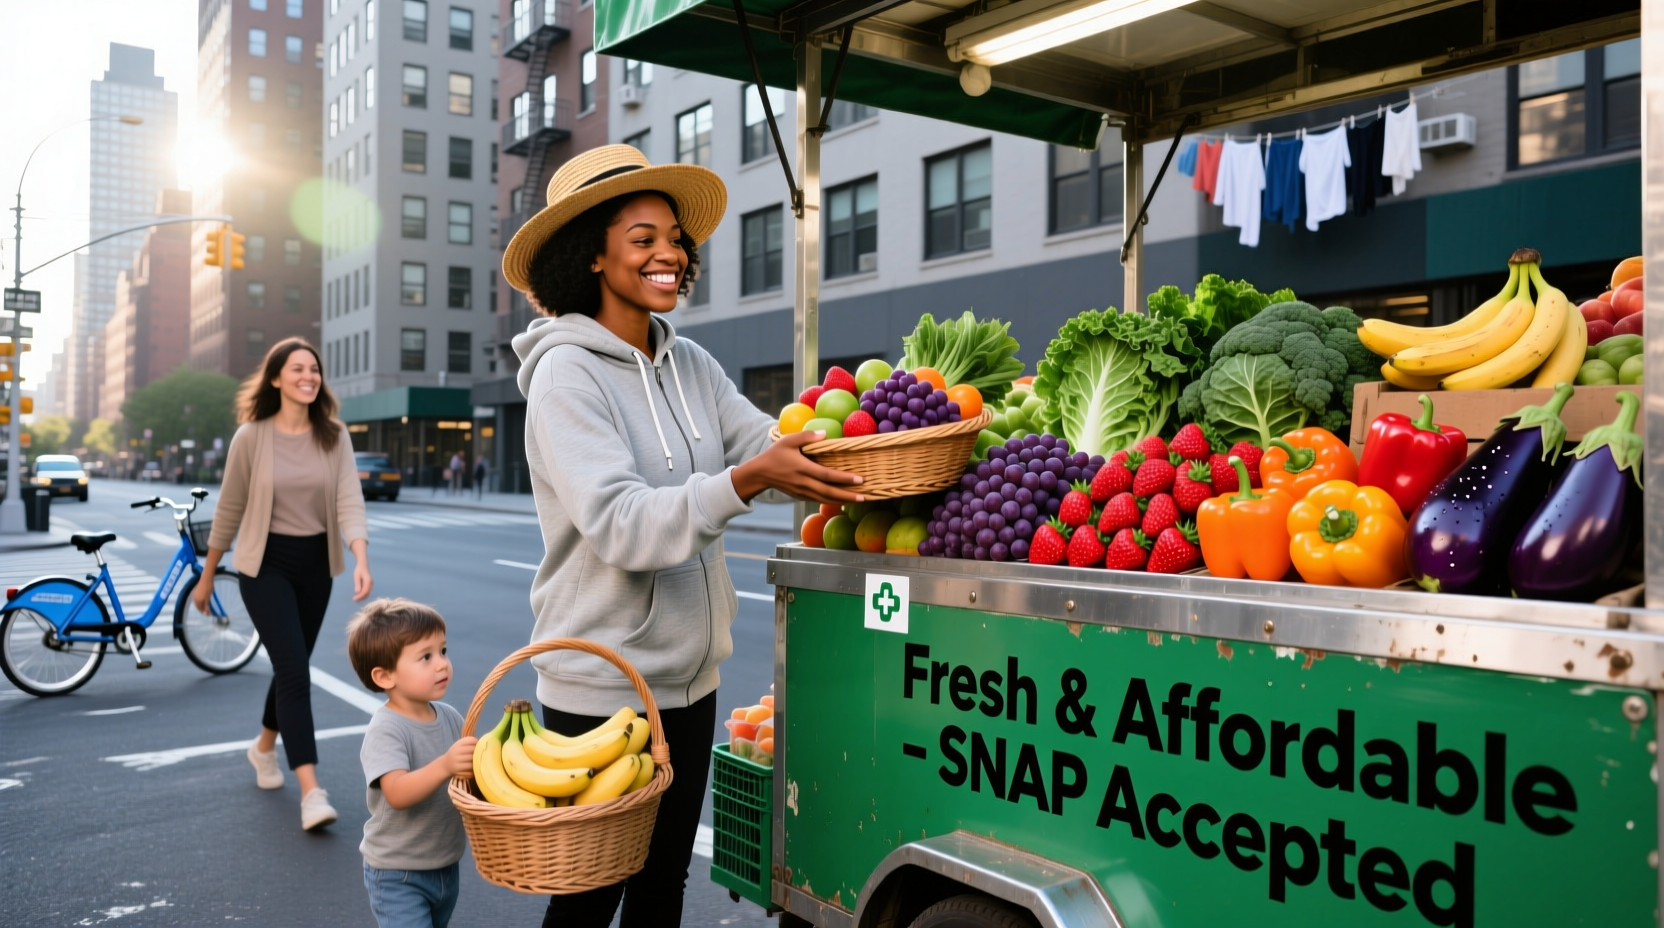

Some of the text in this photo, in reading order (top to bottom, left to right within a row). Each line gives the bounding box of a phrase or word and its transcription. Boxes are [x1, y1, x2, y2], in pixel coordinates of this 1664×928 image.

[903, 642, 1579, 837] Fresh & Affordable
[938, 724, 1088, 816] SNAP
[1095, 764, 1476, 928] Accepted
